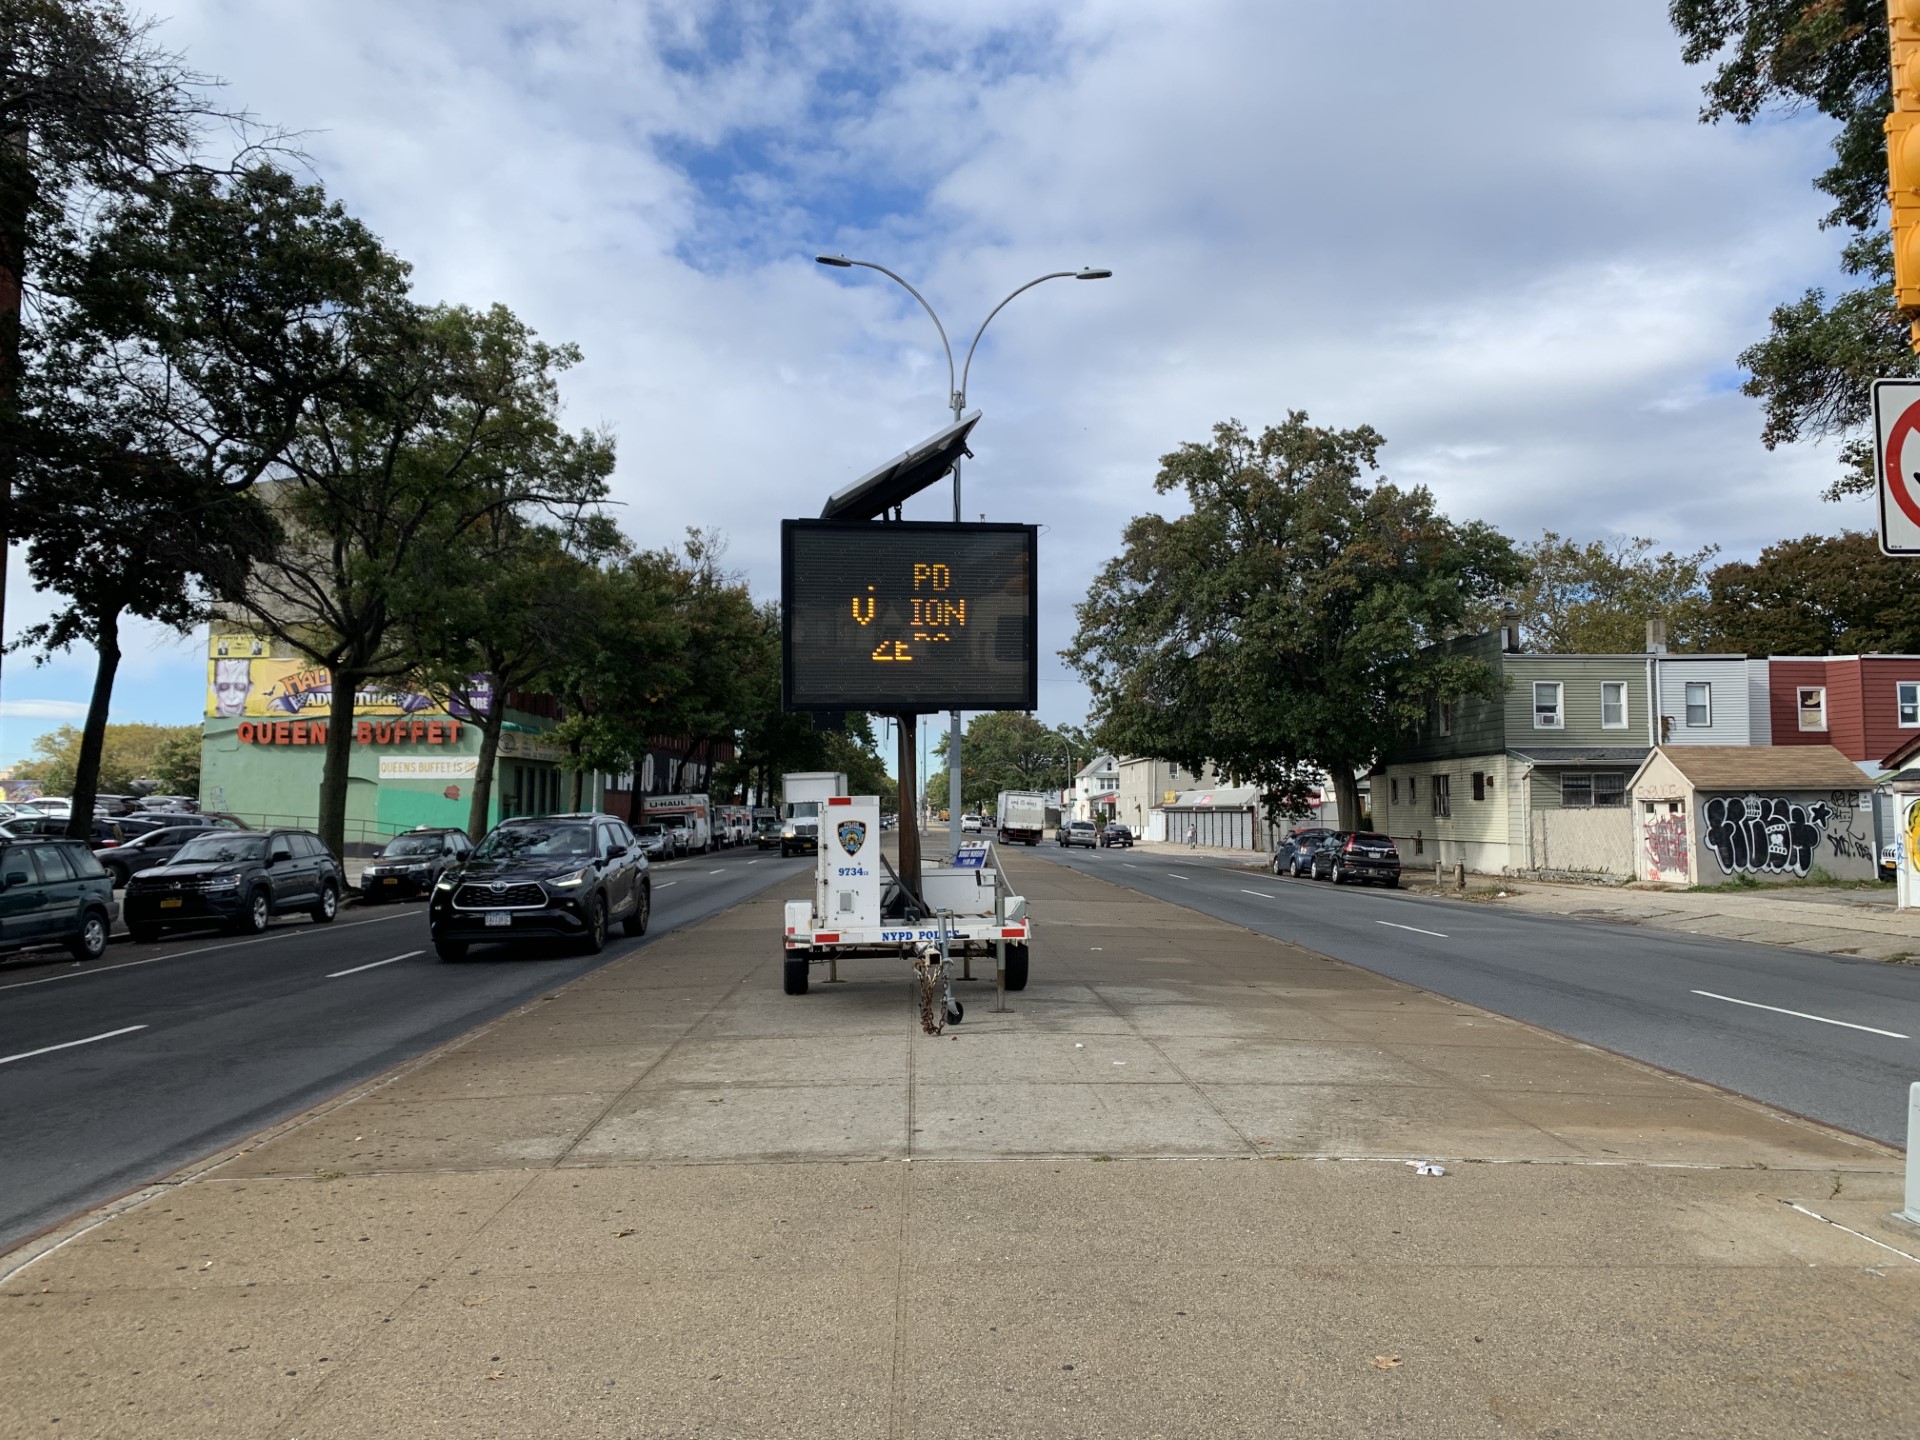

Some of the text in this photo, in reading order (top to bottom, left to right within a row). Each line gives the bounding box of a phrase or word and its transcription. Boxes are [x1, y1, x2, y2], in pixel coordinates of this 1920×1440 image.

[237, 721, 463, 745] QUEEN BUFFET
[381, 762, 416, 773] QUEENS
[419, 762, 451, 773] BUFFET
[454, 762, 463, 773] IS
[649, 800, 686, 808] U-HAUL
[838, 867, 863, 876] 9734
[882, 930, 960, 941] NYPD POLC
